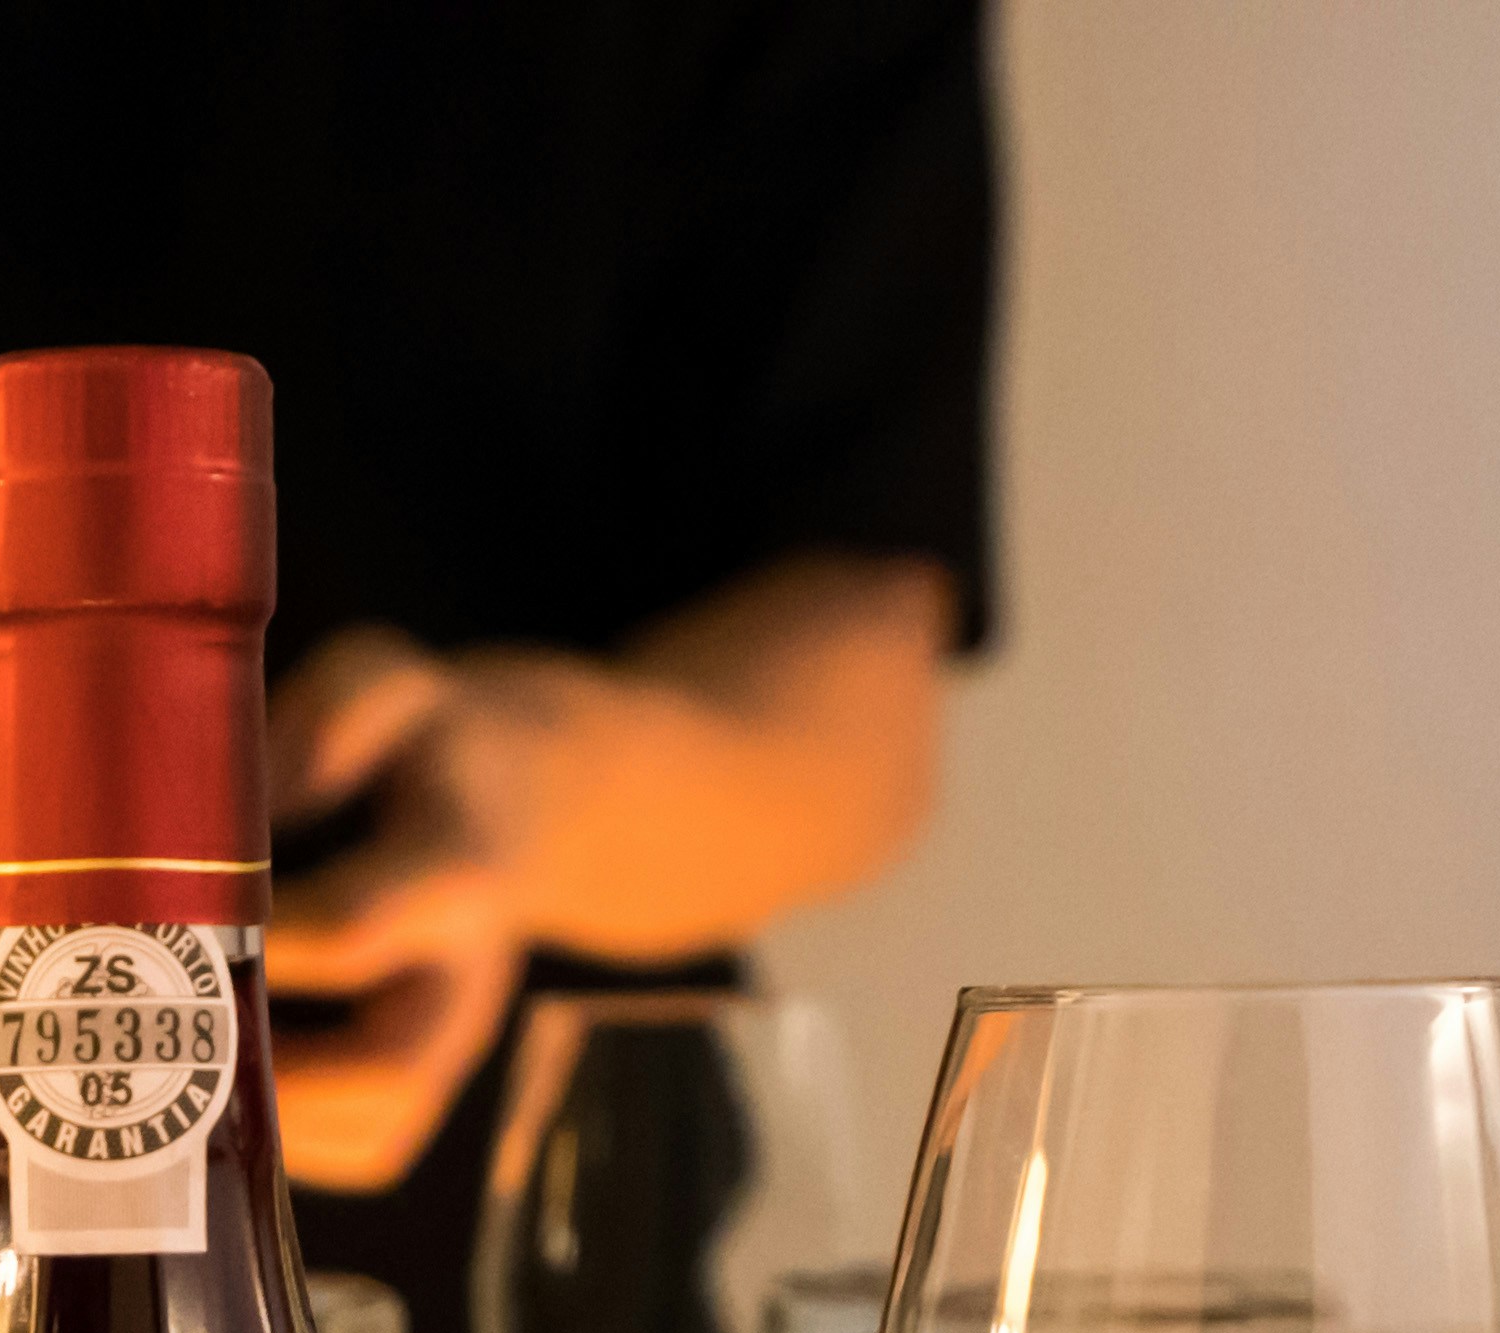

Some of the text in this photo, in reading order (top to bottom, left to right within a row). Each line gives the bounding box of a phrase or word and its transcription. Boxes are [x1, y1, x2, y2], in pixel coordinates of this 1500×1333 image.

[71, 953, 137, 995] ZS
[1, 1006, 216, 1067] 795338
[79, 1071, 134, 1107] 05
[5, 1080, 213, 1160] GARANTIA
